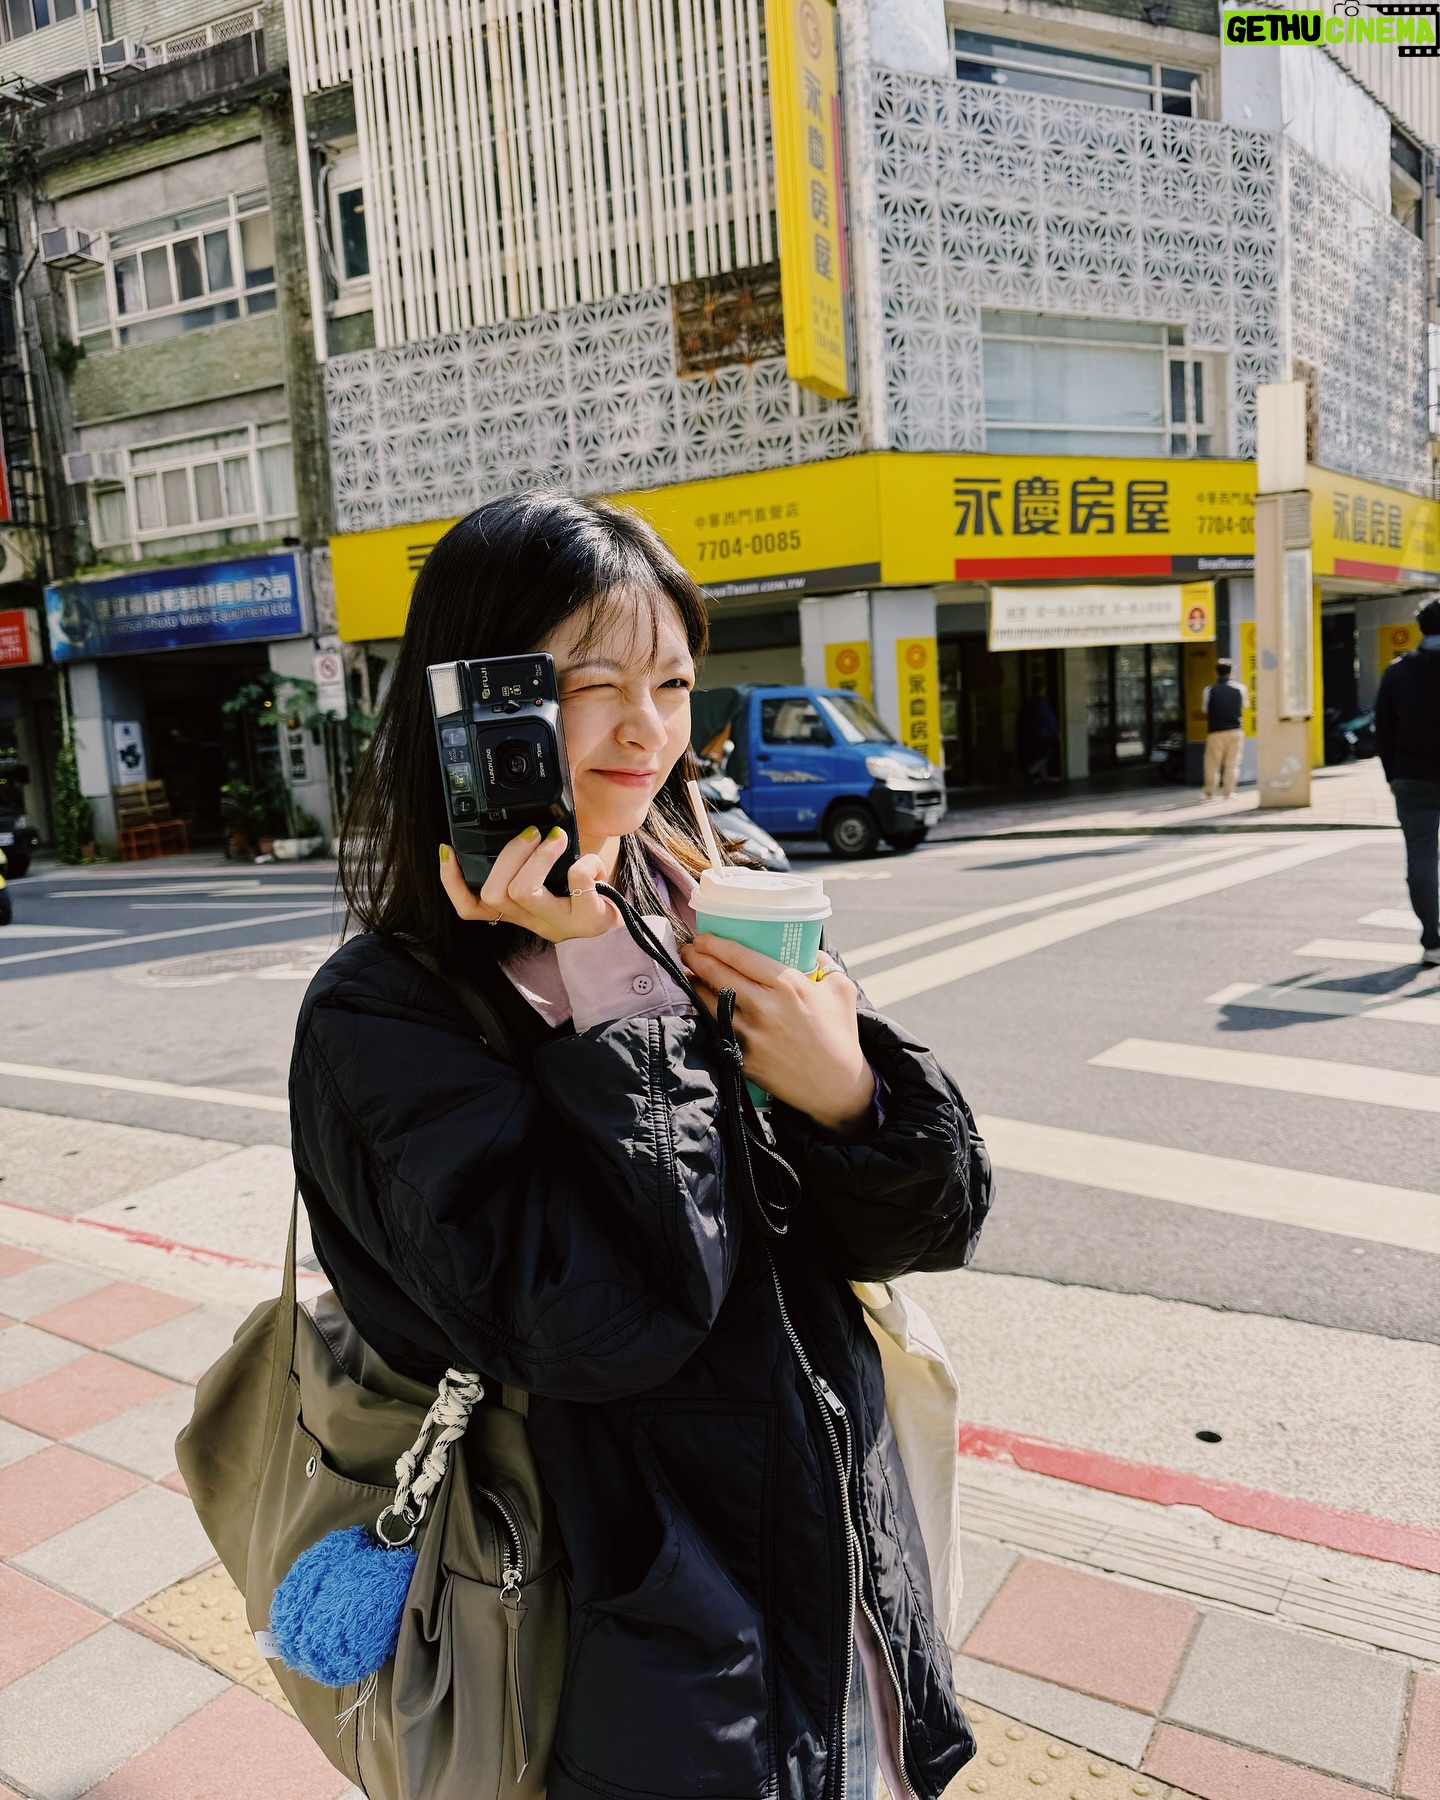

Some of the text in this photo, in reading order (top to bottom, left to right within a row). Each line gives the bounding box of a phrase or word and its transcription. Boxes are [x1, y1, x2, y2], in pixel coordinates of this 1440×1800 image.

[953, 476, 1170, 536] 永慶房屋
[1333, 491, 1402, 549] 永慶房屋
[697, 529, 802, 562] 7704-0085
[481, 667, 489, 687] FUJI
[487, 762, 497, 785] FUJINON
